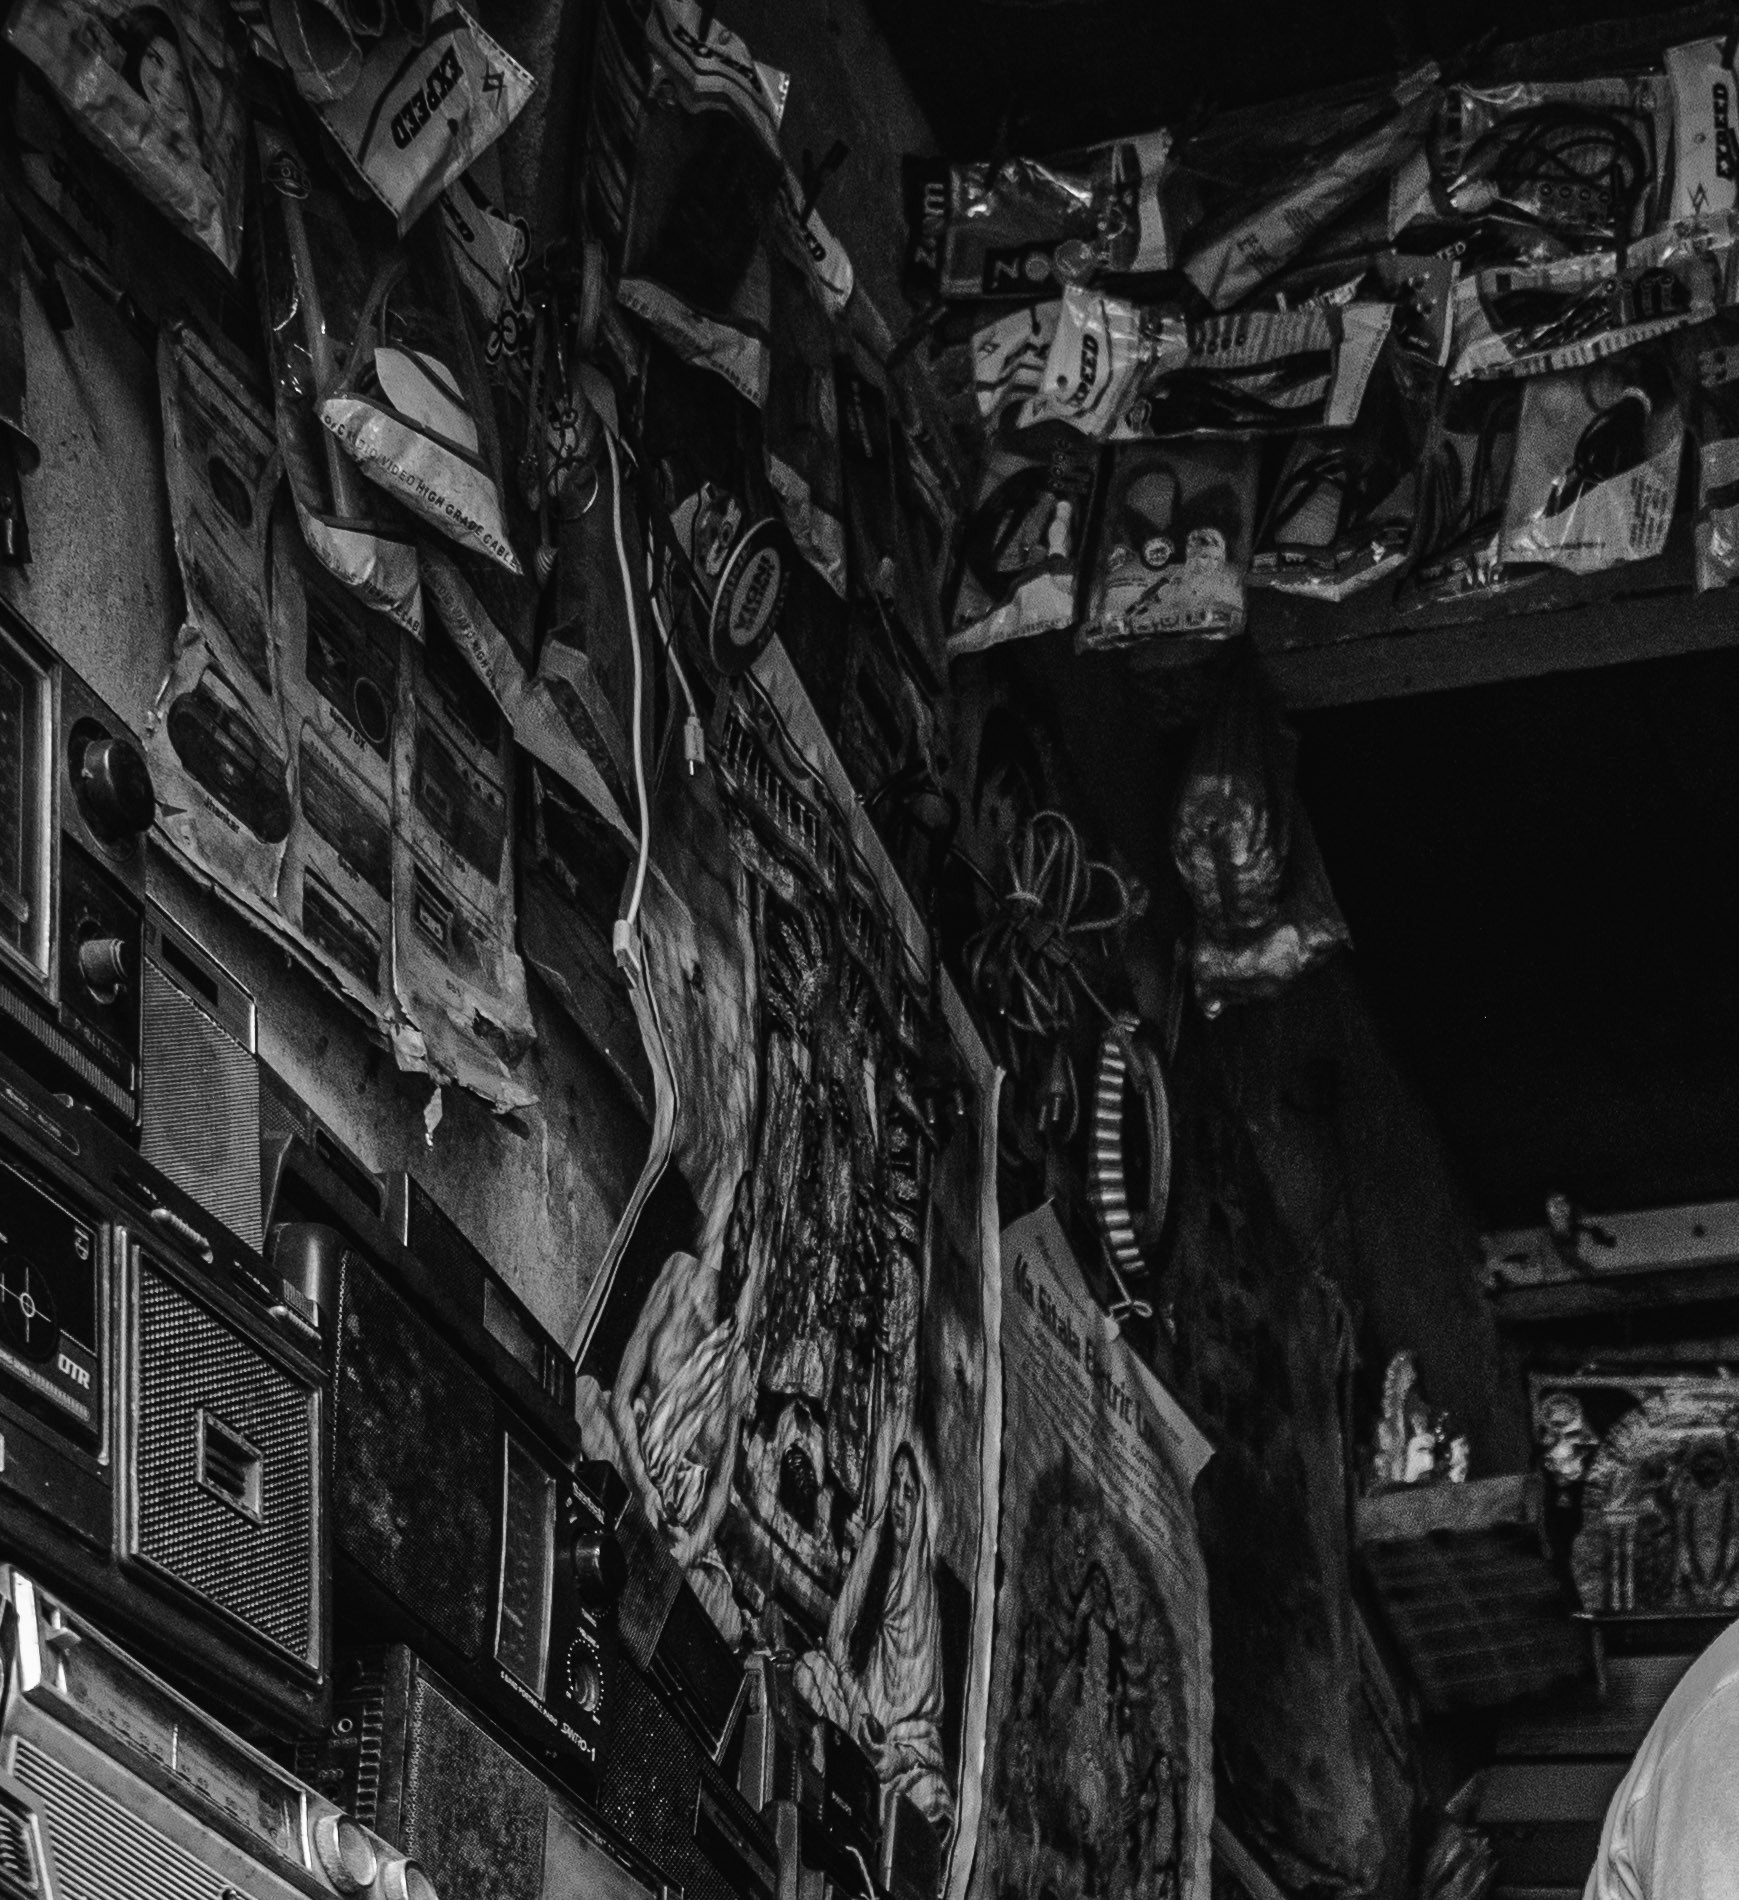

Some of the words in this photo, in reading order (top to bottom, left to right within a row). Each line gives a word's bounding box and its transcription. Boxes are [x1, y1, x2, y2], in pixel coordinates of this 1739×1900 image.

[391, 45, 464, 150] EXPEED
[379, 455, 416, 488] VIDEO
[416, 480, 445, 508] HIGH
[445, 503, 484, 537] GRADE
